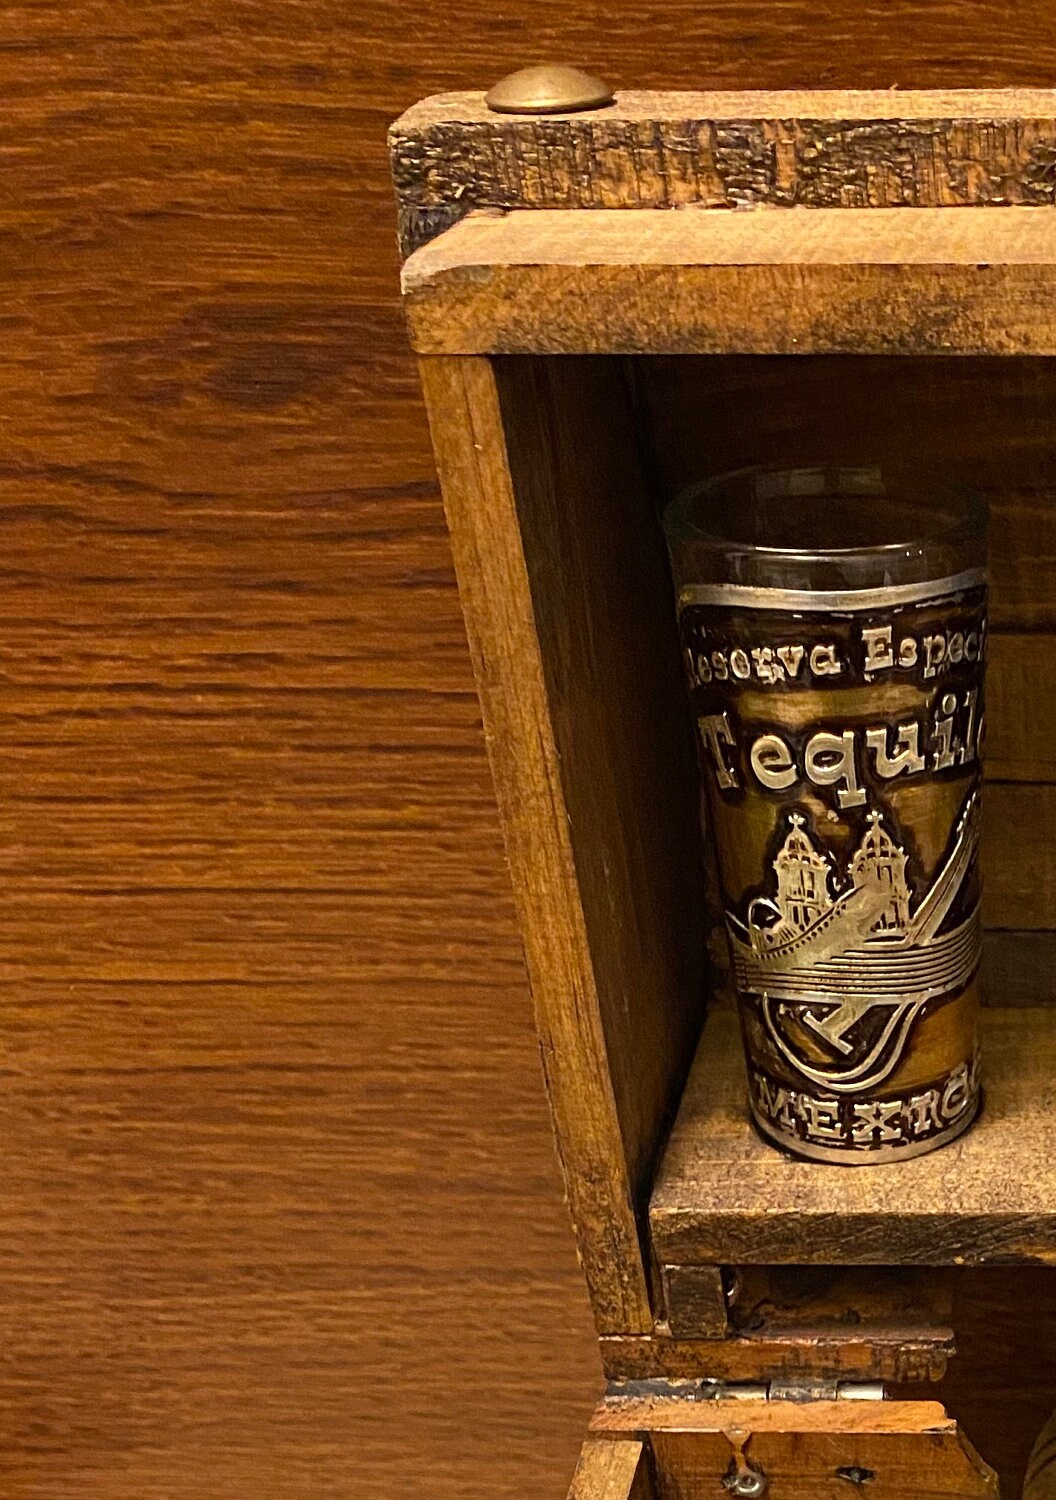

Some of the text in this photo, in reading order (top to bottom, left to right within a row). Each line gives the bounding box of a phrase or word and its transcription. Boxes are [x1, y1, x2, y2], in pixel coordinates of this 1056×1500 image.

[688, 644, 842, 686] eserva
[698, 690, 984, 809] Tequil
[754, 1061, 970, 1141] MEXIC
